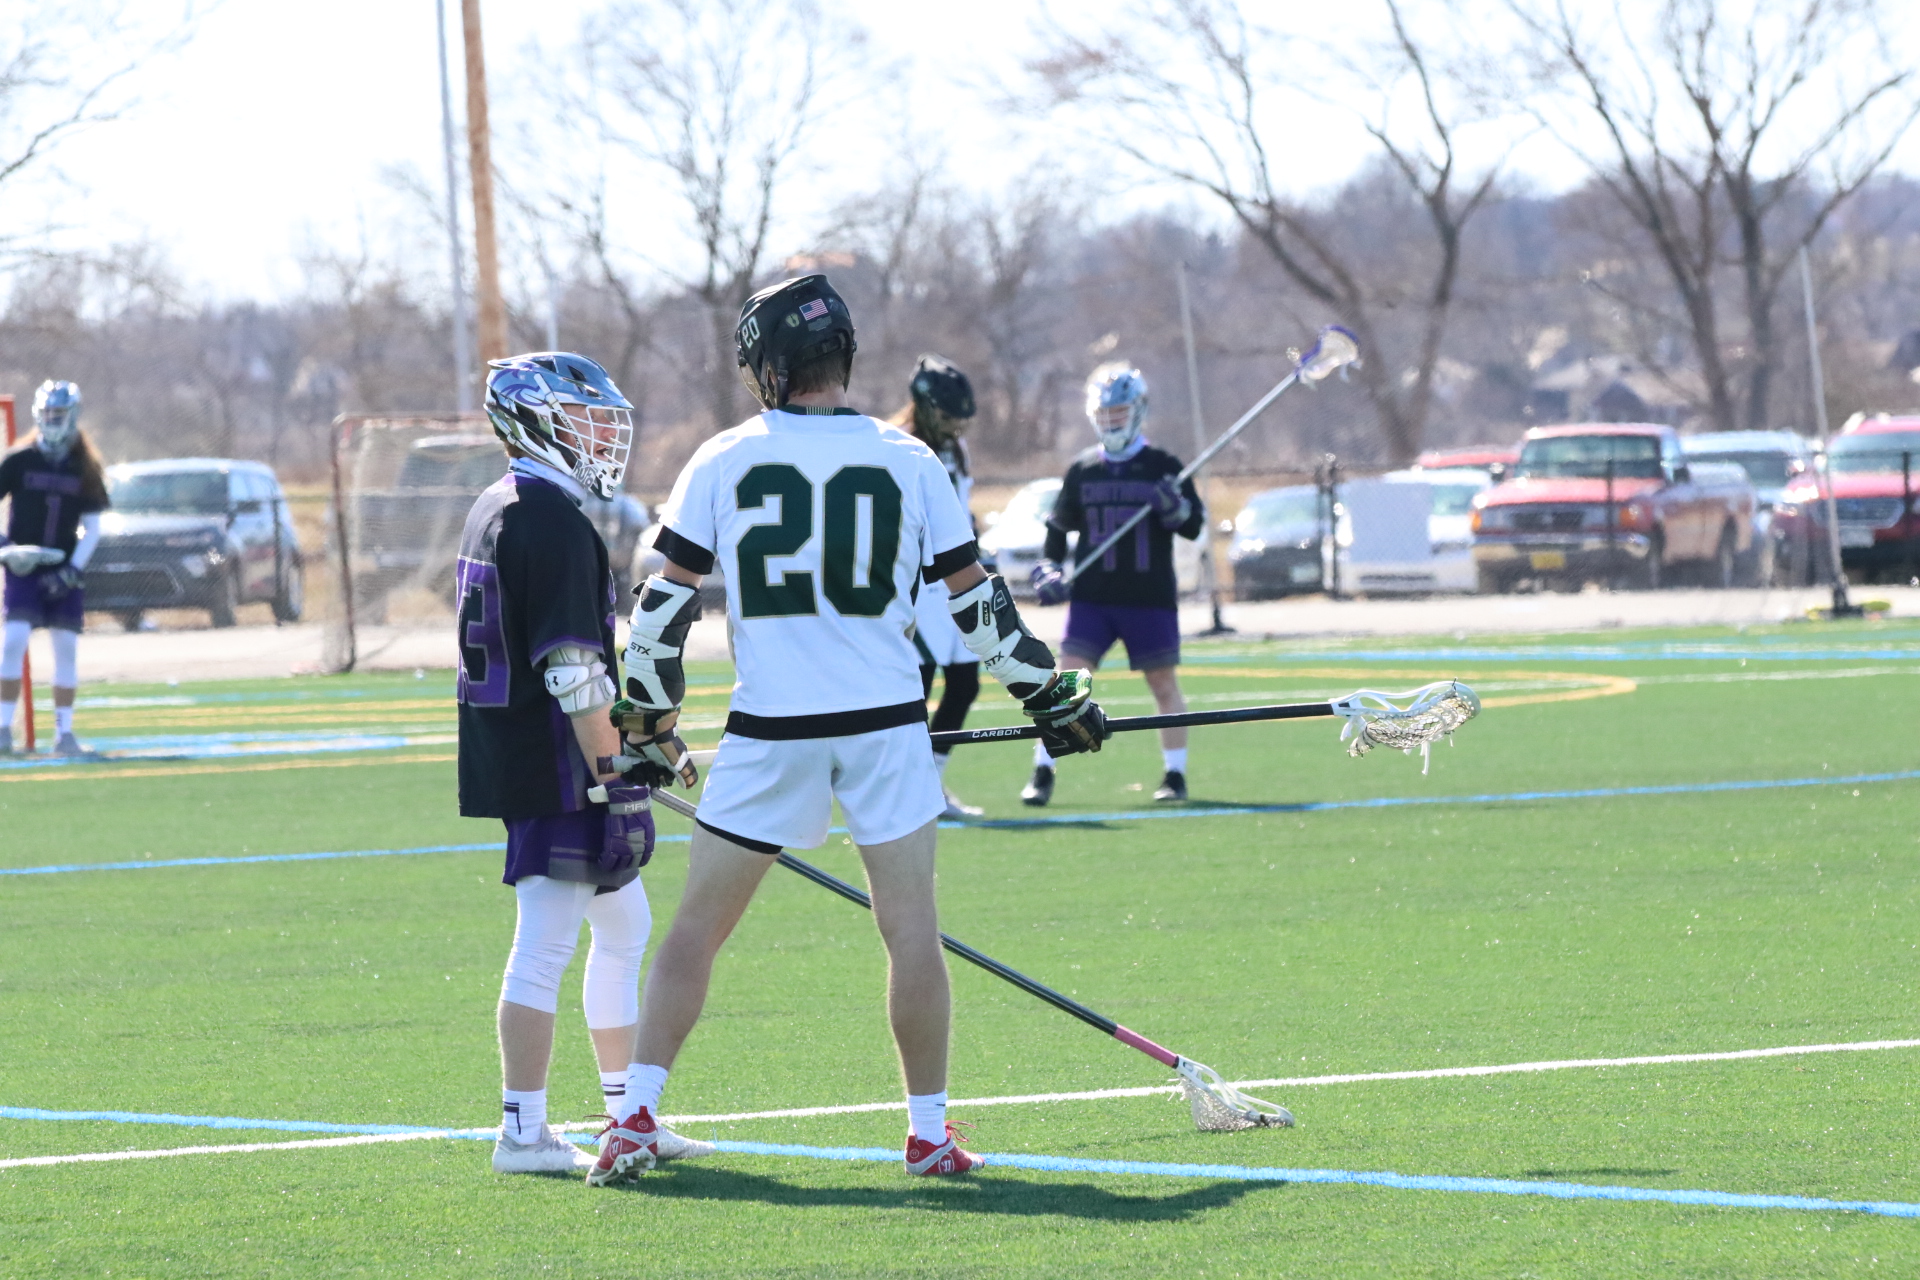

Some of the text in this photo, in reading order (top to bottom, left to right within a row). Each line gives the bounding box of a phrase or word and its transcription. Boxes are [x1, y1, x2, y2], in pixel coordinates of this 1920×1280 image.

[741, 315, 760, 349] 20
[734, 462, 904, 620] 20
[1086, 506, 1150, 572] 47
[456, 556, 512, 708] 3
[630, 641, 652, 656] STX
[984, 650, 1005, 667] STX
[972, 728, 1022, 739] CARBON
